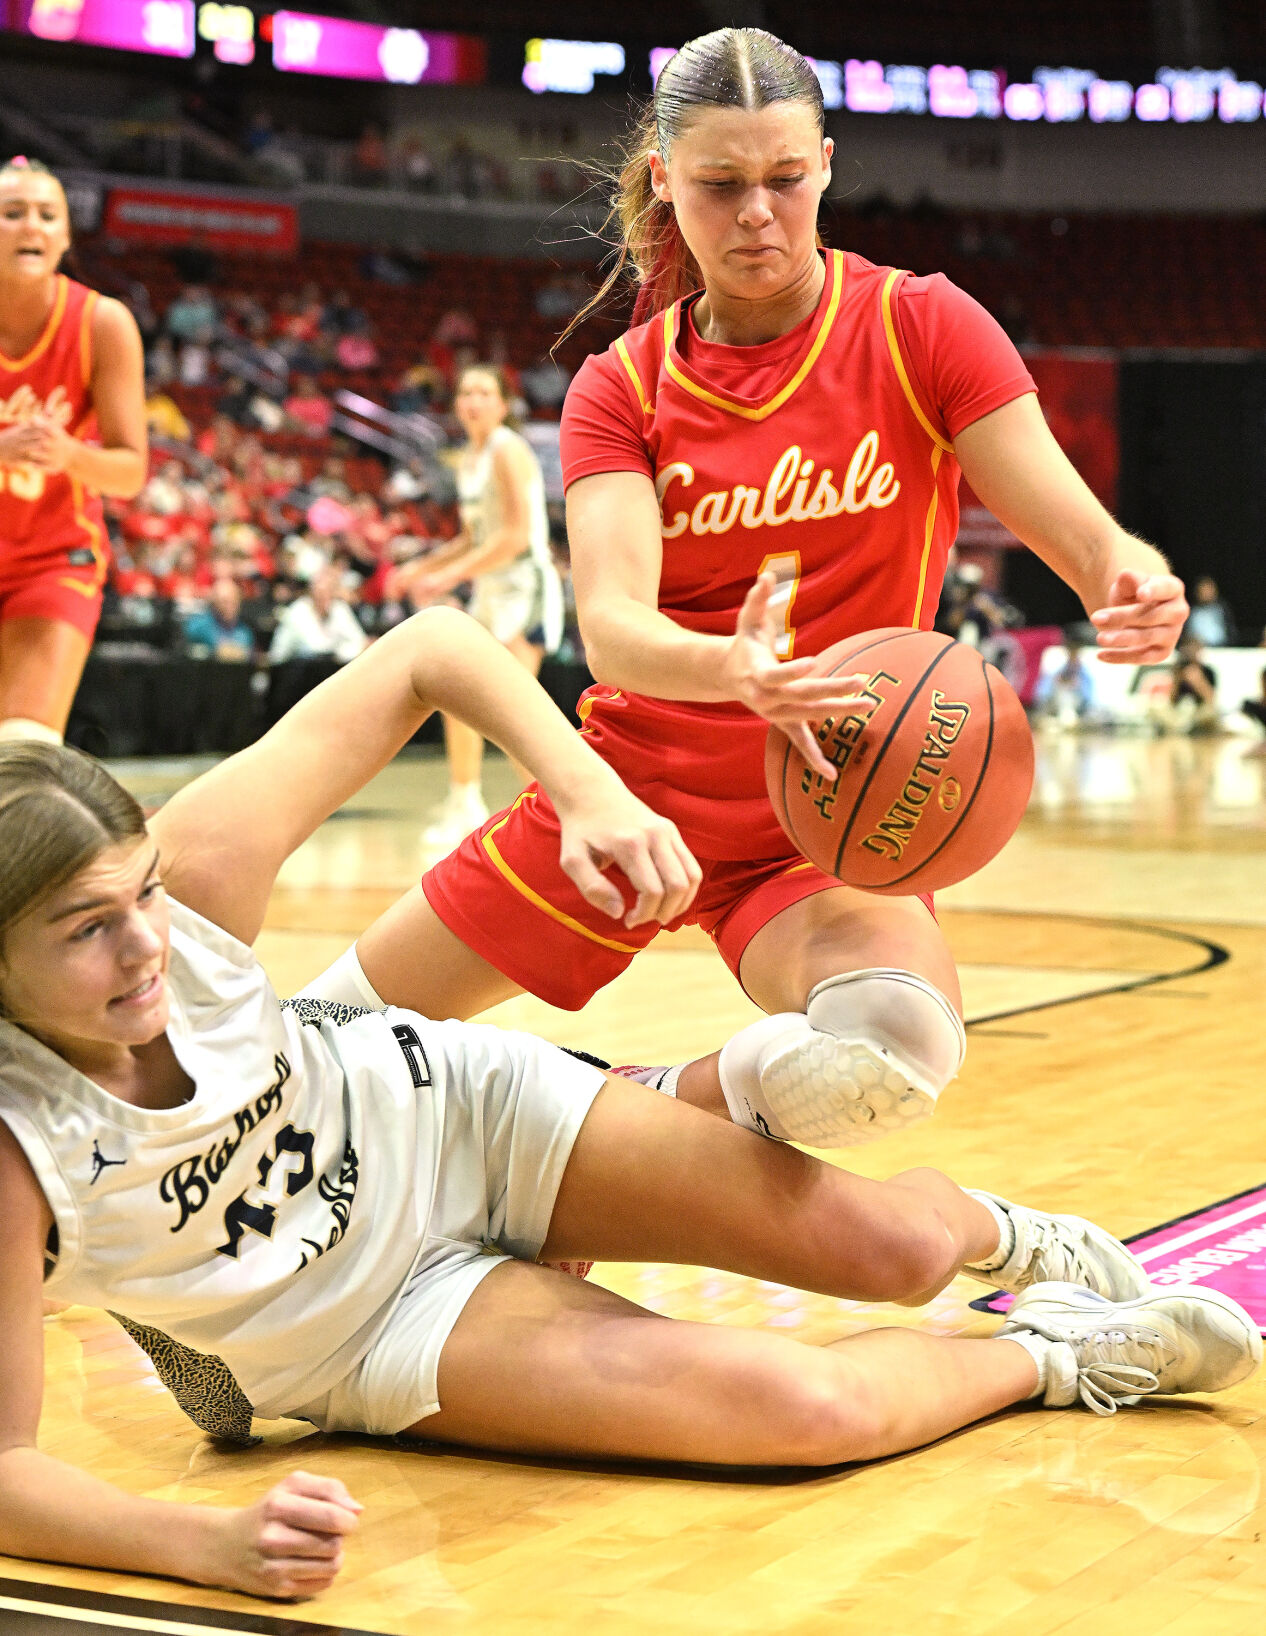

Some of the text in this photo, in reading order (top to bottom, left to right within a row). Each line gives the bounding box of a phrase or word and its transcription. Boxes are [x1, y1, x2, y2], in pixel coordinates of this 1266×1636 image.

[654, 430, 900, 538] Carlisle
[757, 550, 801, 660] 1
[859, 690, 972, 862] SPALDING
